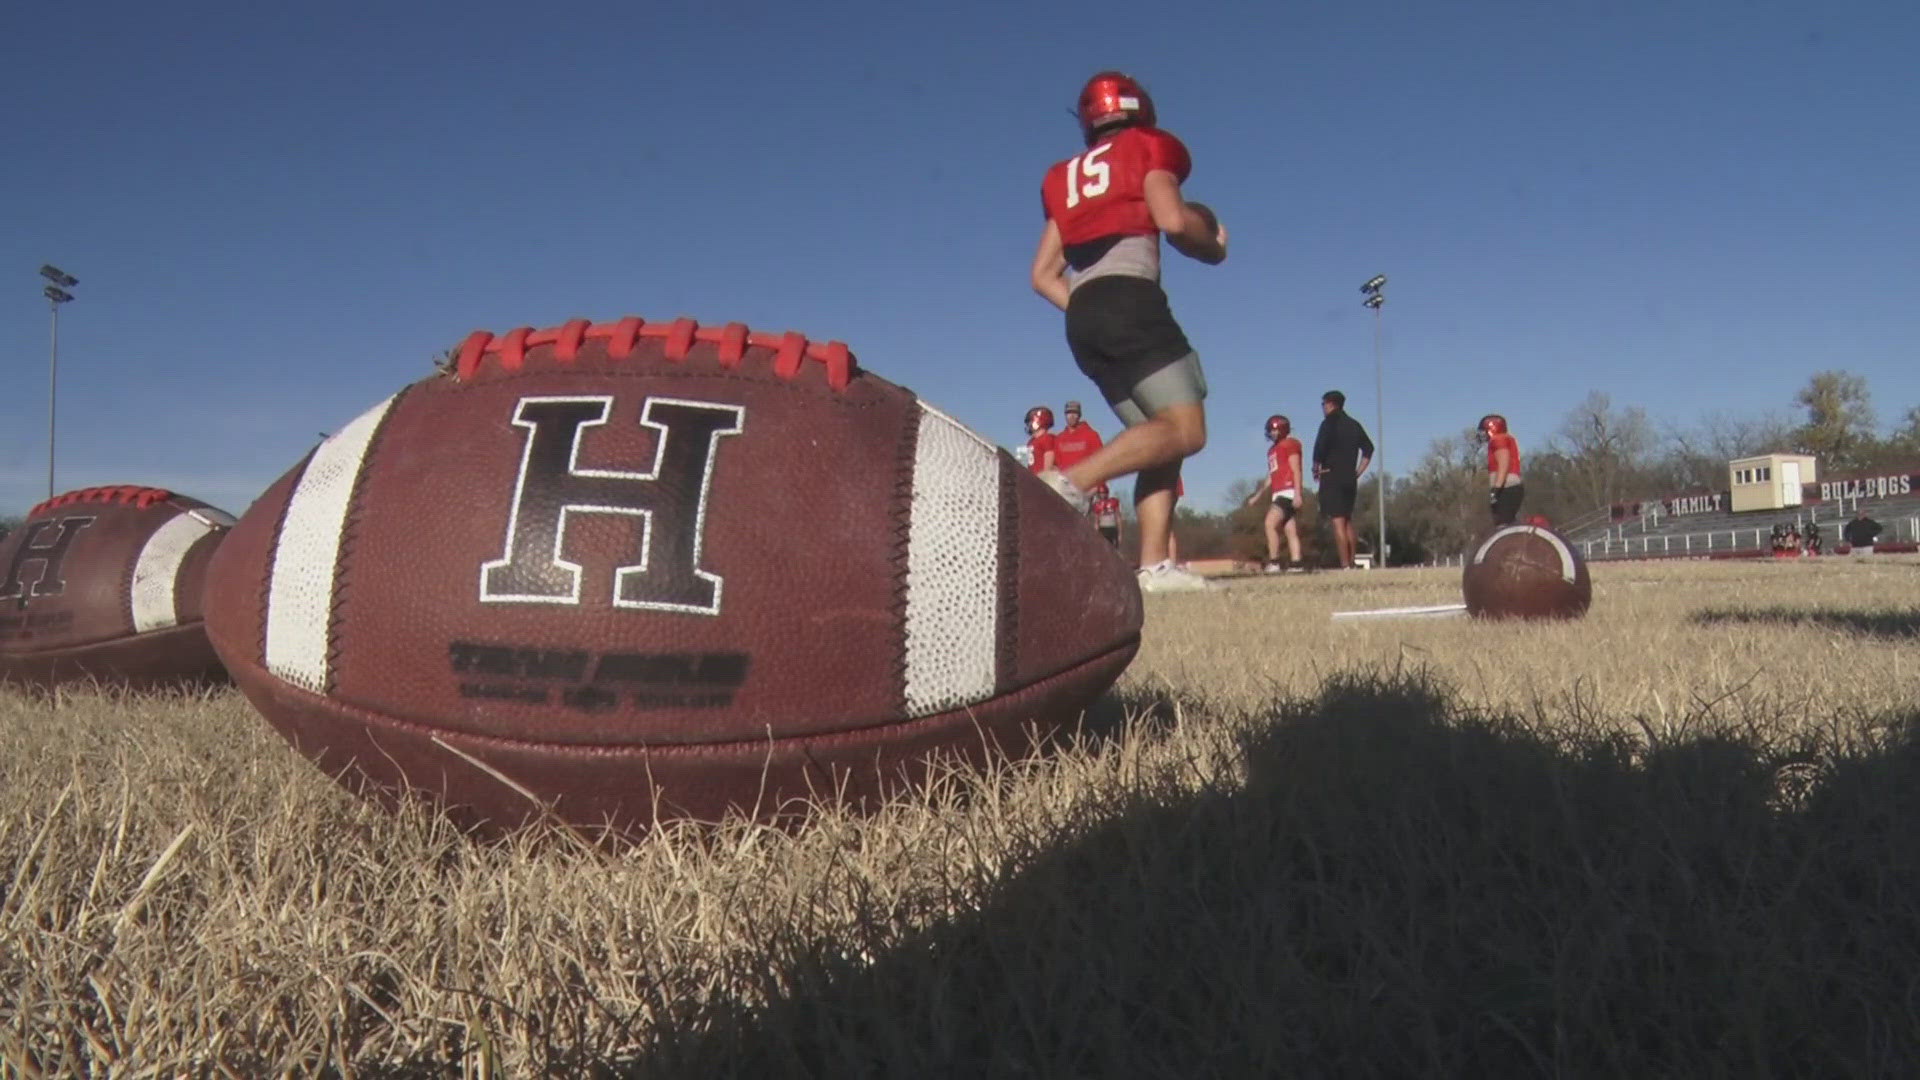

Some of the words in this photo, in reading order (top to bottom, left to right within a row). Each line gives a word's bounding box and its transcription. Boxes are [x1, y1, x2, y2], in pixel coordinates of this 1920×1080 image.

[1066, 143, 1112, 209] 15
[480, 396, 745, 615] H
[1821, 475, 1911, 501] BULLDOGS
[0, 516, 97, 599] H
